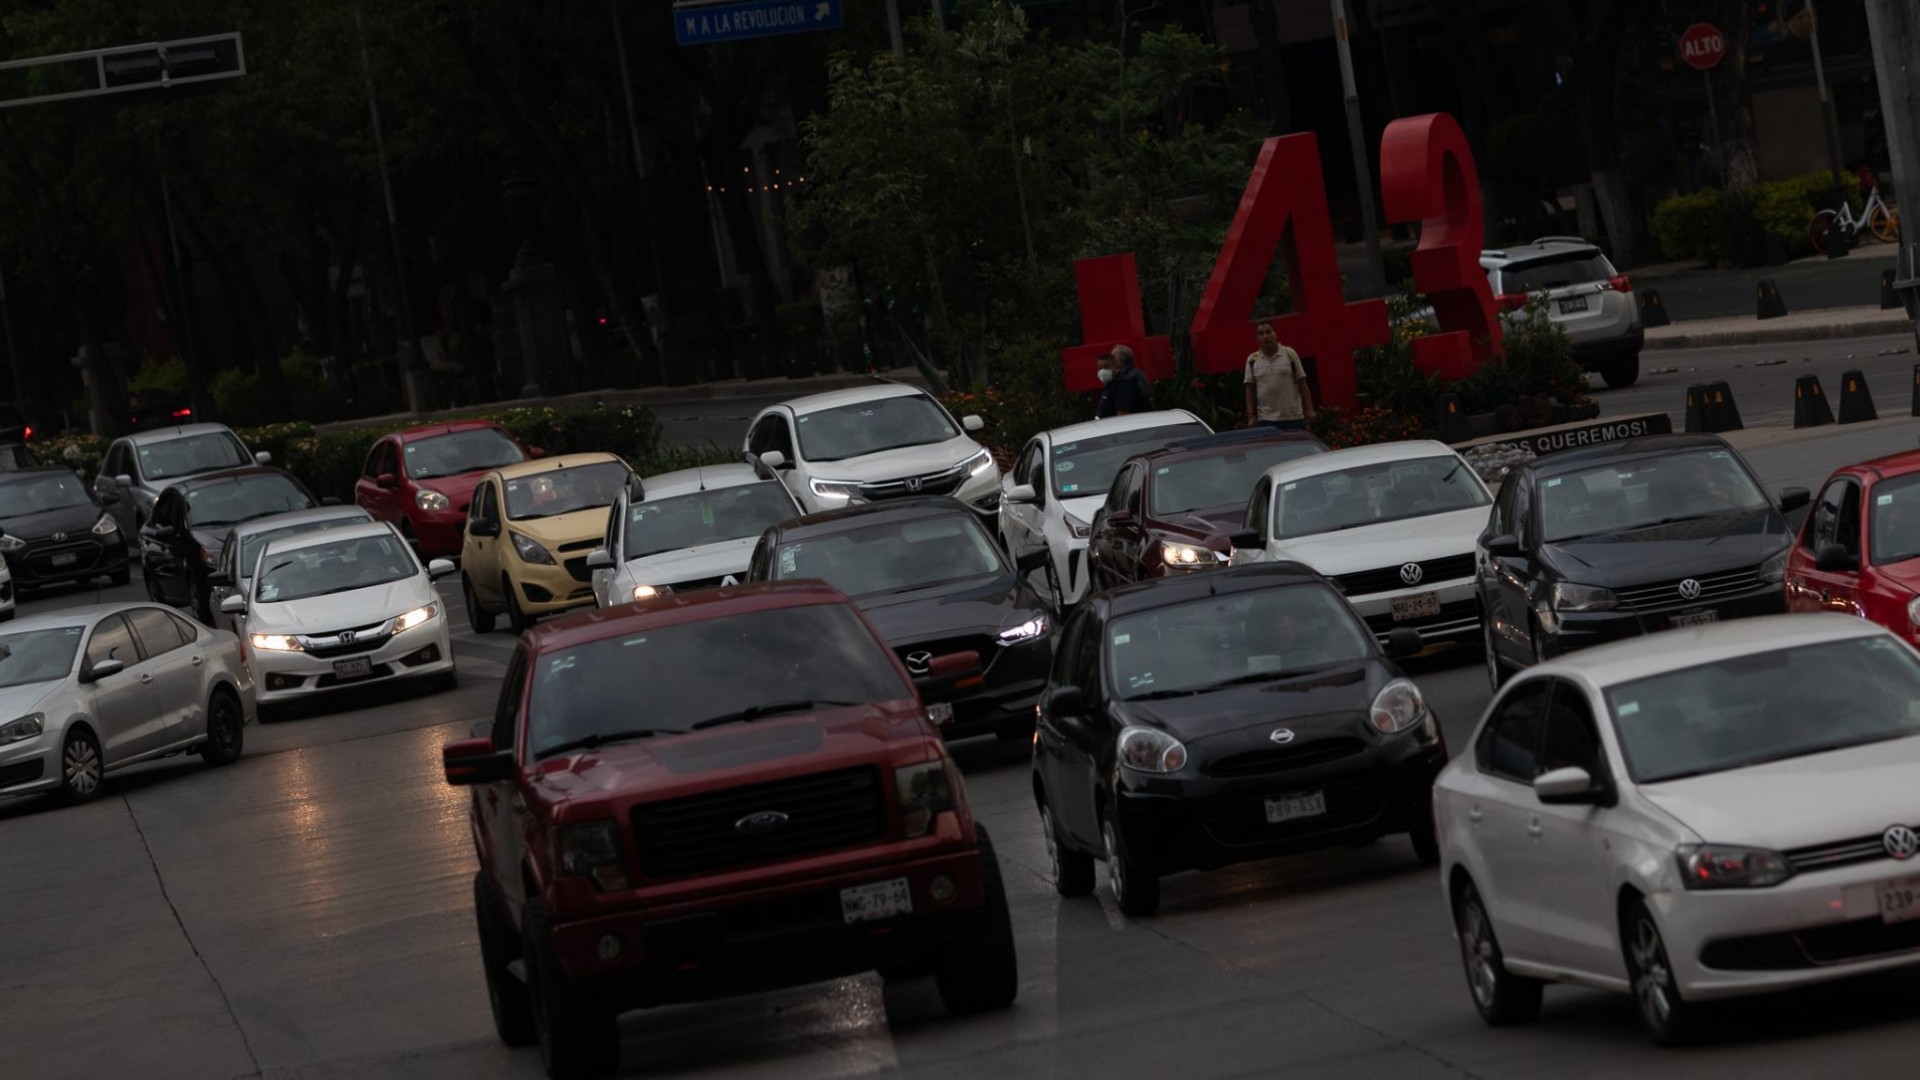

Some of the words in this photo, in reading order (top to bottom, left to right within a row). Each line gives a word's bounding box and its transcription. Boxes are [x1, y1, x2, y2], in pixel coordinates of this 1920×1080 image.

[701, 15, 712, 35] A
[714, 13, 732, 33] LA
[733, 4, 806, 31] REVOLUCION
[1685, 34, 1721, 57] ALTO
[1536, 420, 1649, 453] QUEREMOS!
